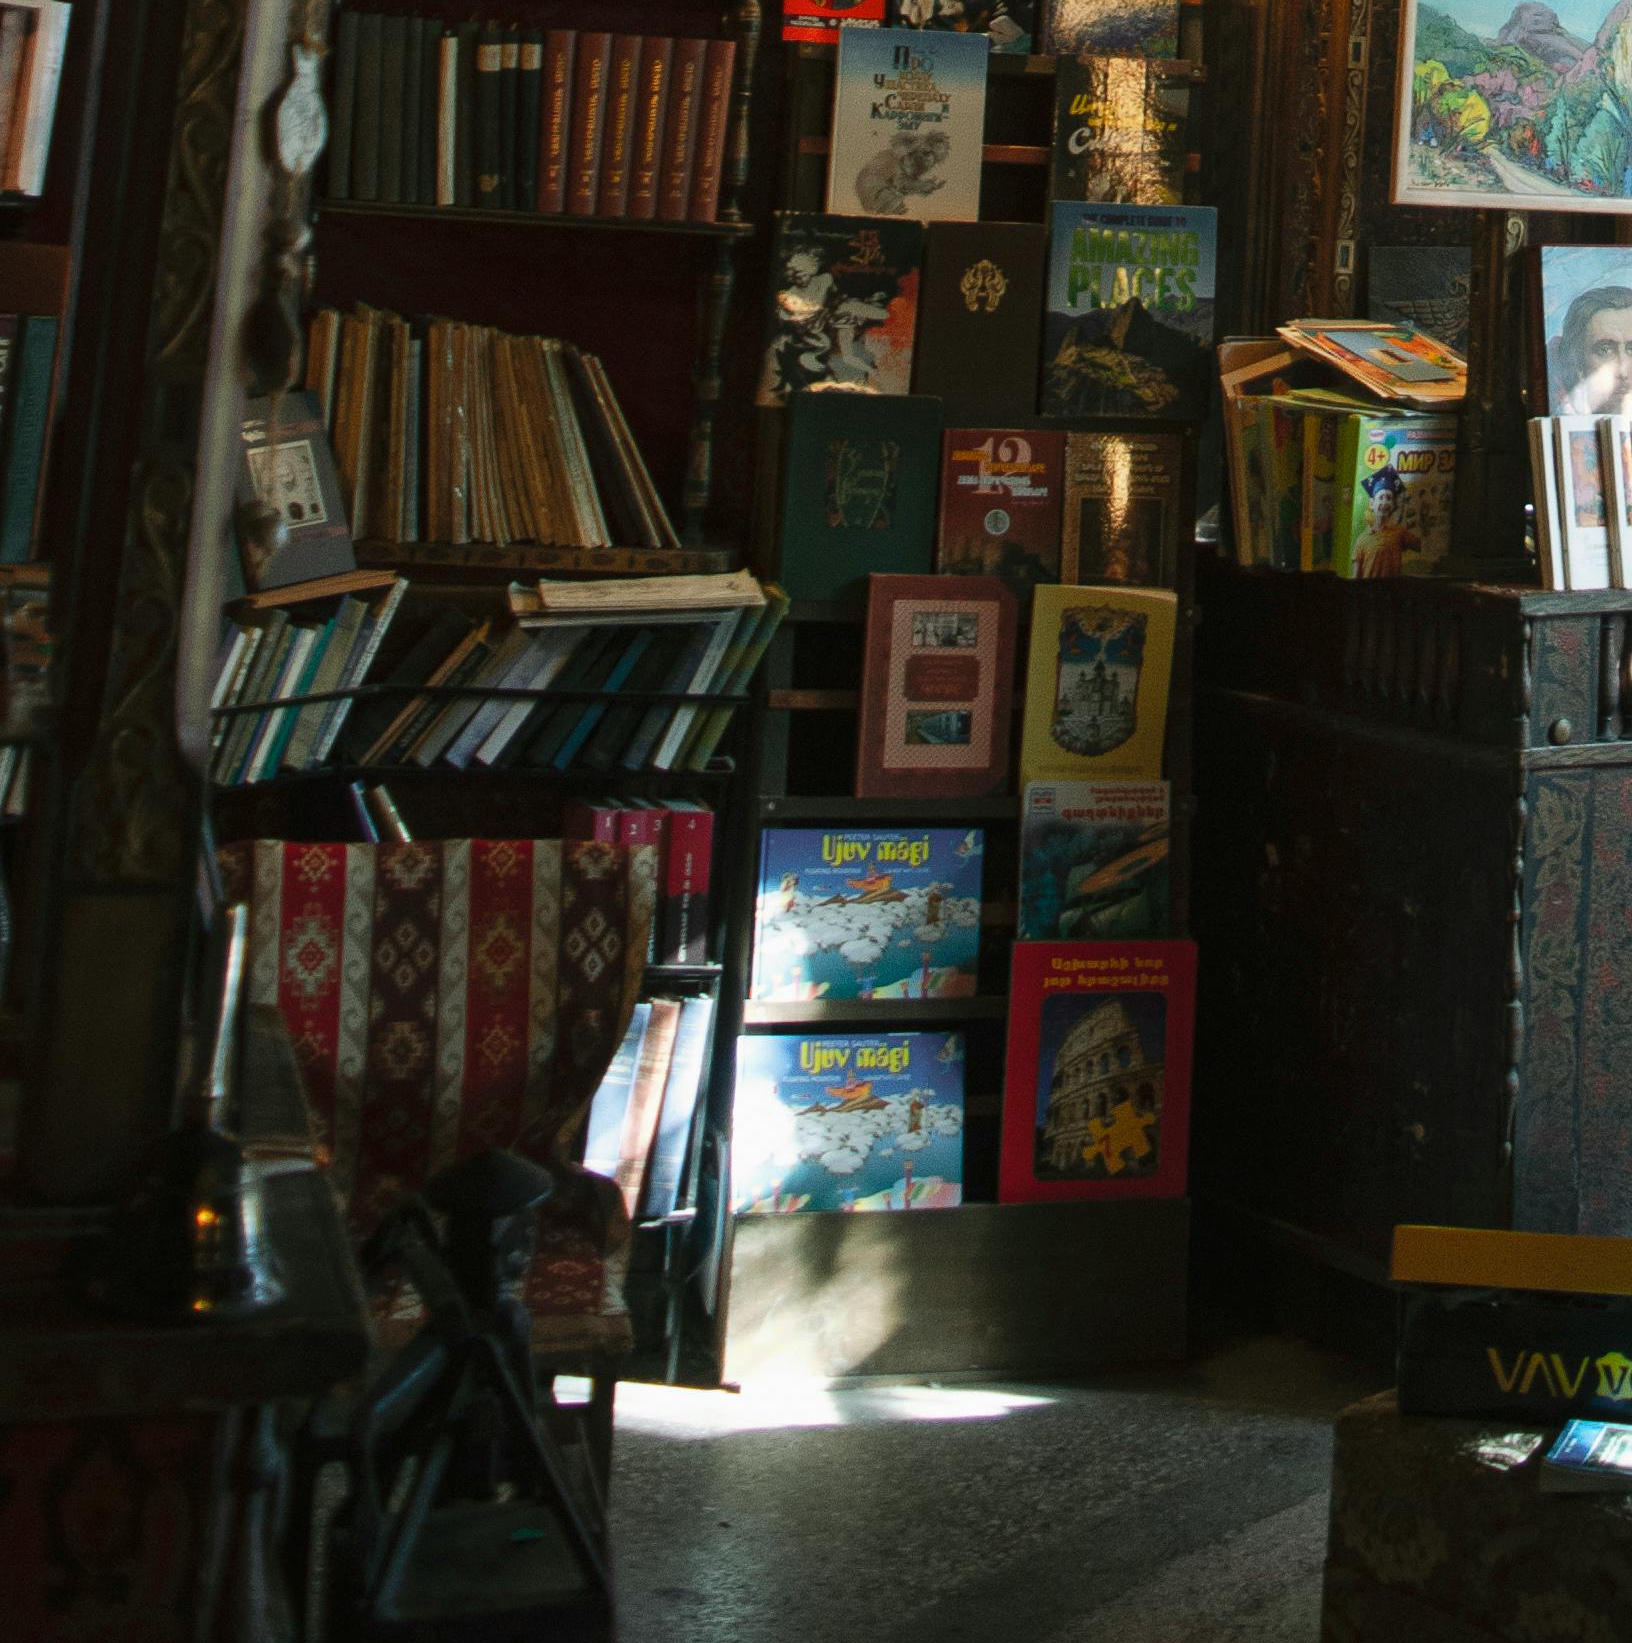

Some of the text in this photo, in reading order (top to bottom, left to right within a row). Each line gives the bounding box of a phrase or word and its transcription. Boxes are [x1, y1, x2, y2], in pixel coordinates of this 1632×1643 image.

[1071, 227, 1200, 266] AMAZING
[1067, 265, 1197, 313] PLACES
[971, 437, 1033, 495] 12
[1366, 446, 1386, 468] 4+
[1397, 449, 1436, 474] МИР
[604, 816, 612, 829] 1
[629, 823, 637, 836] 2
[654, 819, 662, 832] 3
[687, 818, 696, 830] 4
